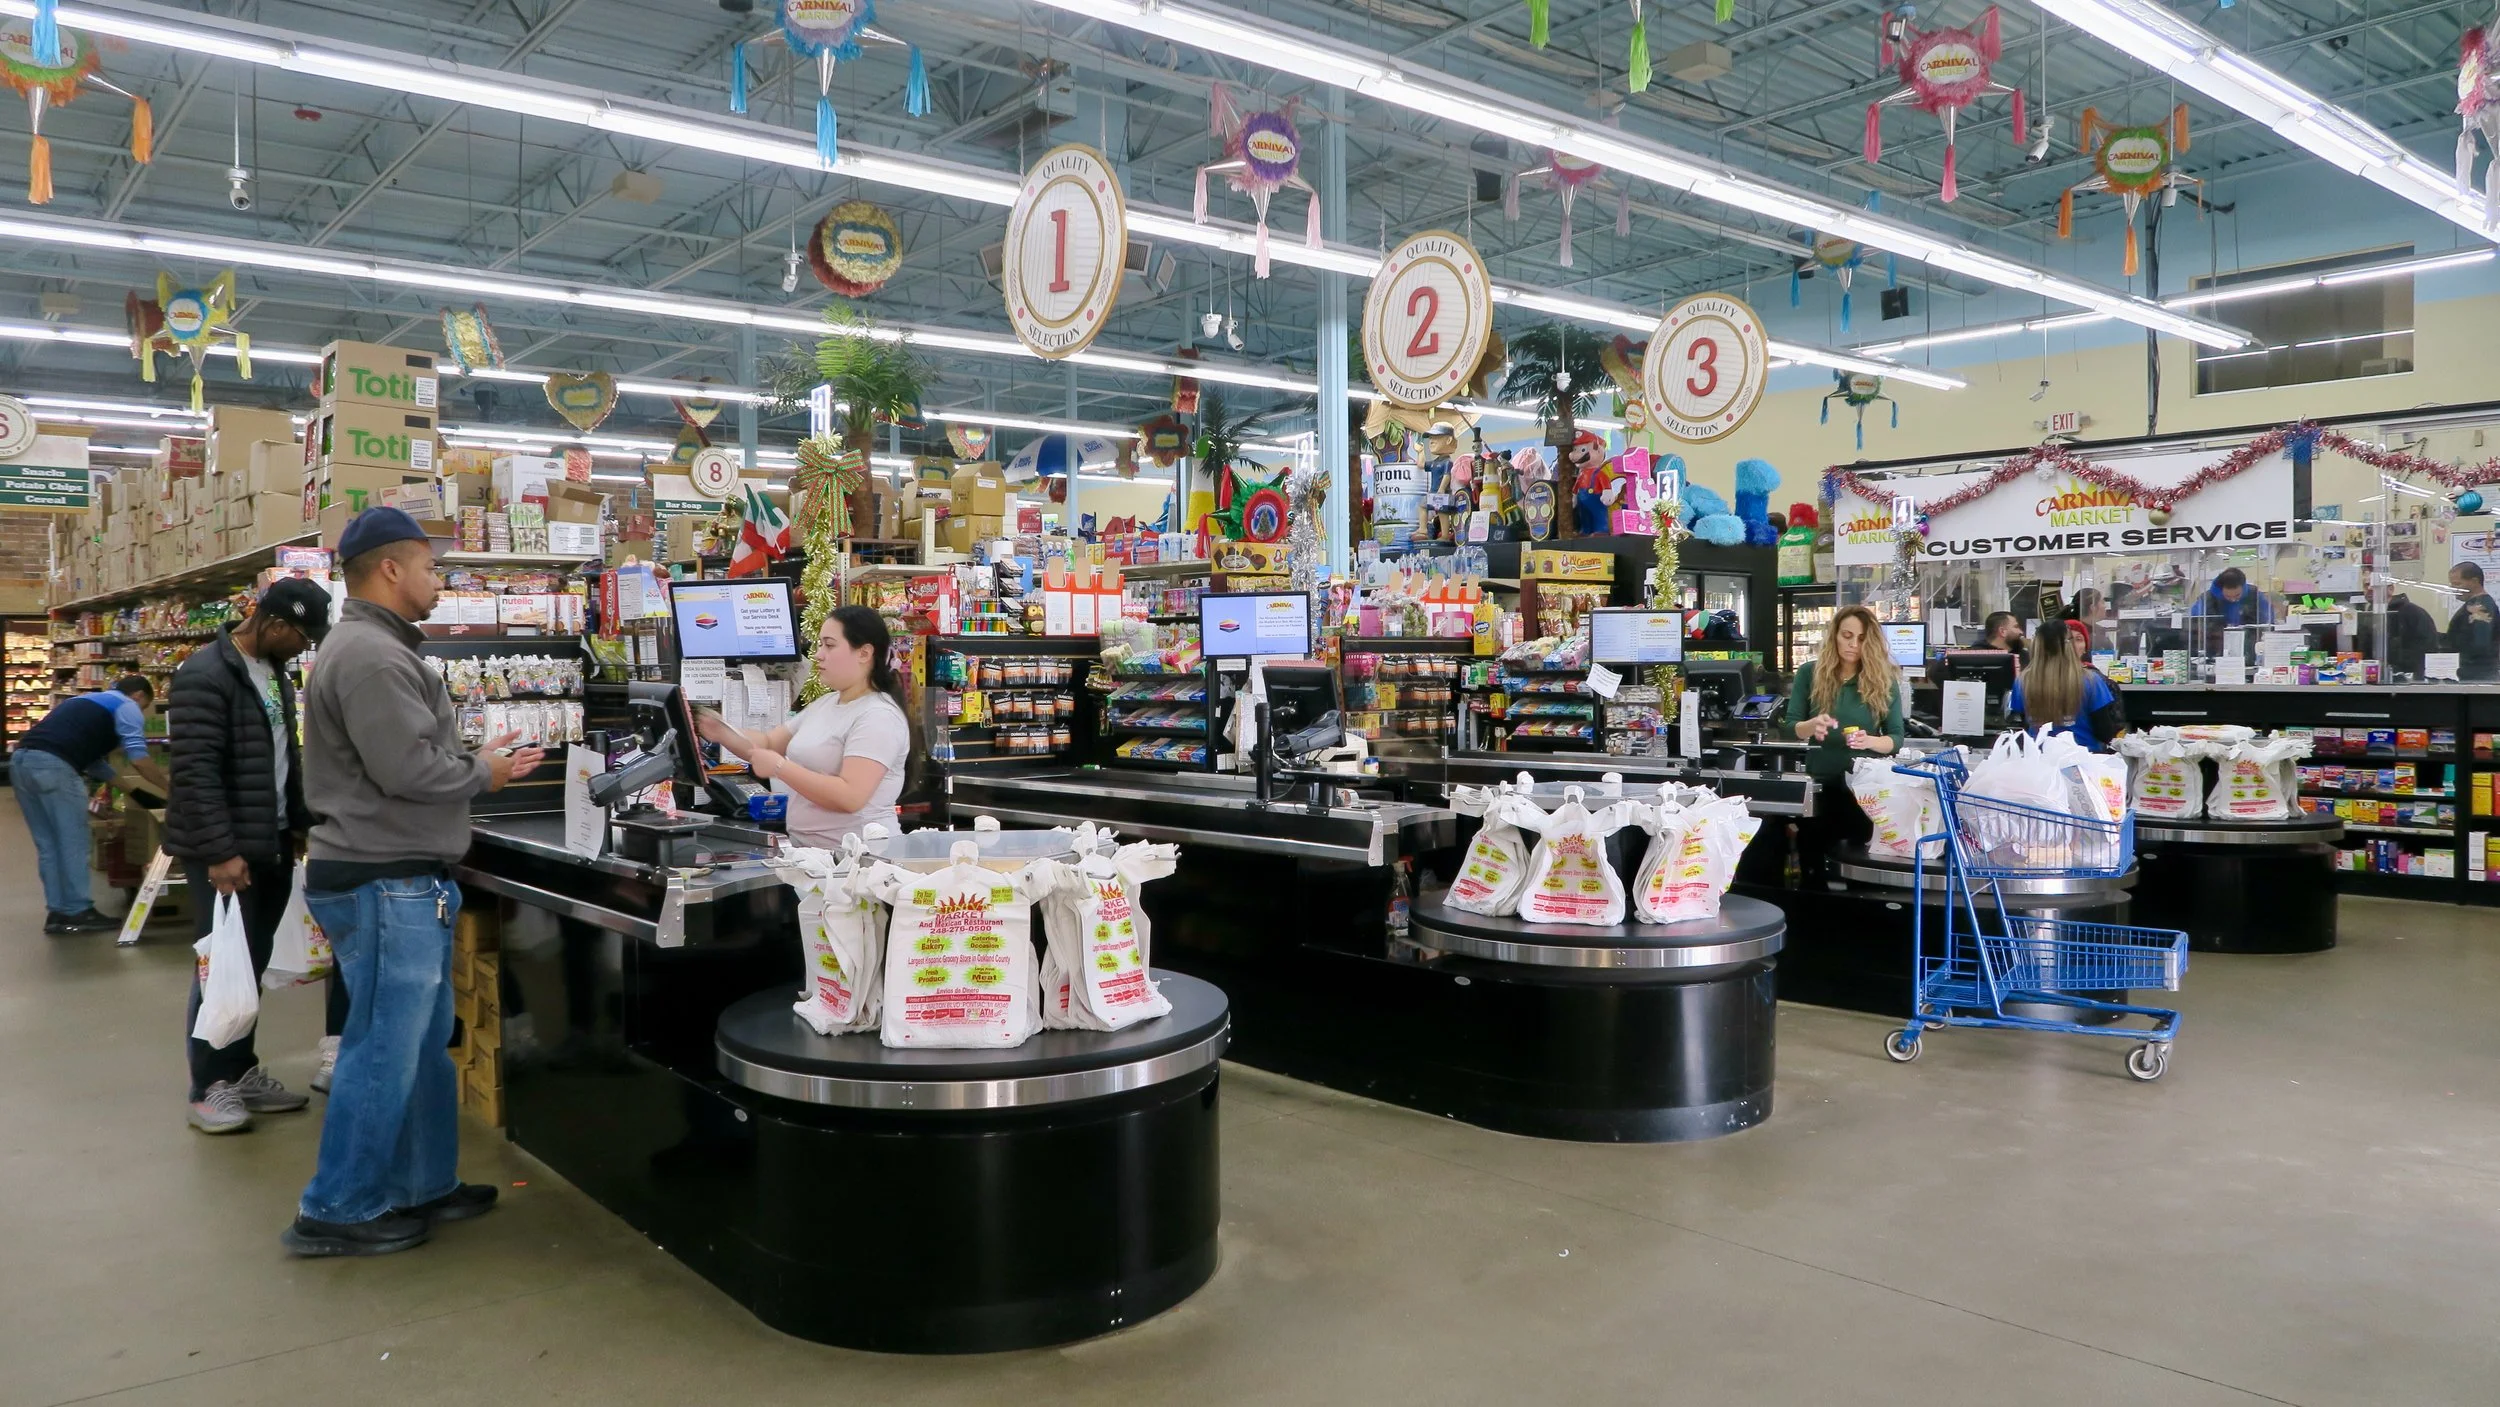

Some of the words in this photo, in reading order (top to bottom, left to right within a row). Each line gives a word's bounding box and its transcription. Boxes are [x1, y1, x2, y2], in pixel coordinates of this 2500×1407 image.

[788, 0, 853, 13] CARNIVAL
[0, 33, 75, 58] CARAL
[1920, 57, 1978, 72] CARNIVAL
[1248, 140, 1294, 155] CARNIVAL
[2108, 152, 2160, 162] CARNIVAL
[1042, 156, 1092, 179] QUALITY
[1049, 209, 1070, 293] 1
[1406, 240, 1458, 259] QUALITY
[1687, 302, 1738, 318] QUALITY
[1406, 286, 1439, 358] 2
[1027, 323, 1081, 348] SELECTION
[1686, 337, 1718, 397] 3
[1388, 378, 1444, 400] SELECTION
[1664, 416, 1719, 436] SELECTION
[2052, 412, 2074, 431] EXIT
[348, 429, 410, 460] Toti
[22, 468, 66, 478] Snacks
[710, 462, 722, 482] 8
[1375, 468, 1412, 481] orona
[6, 480, 46, 490] Potato
[48, 482, 84, 492] Chips
[1376, 484, 1400, 494] Extra
[1662, 478, 1672, 500] 3
[24, 495, 66, 504] Cereal
[681, 502, 702, 510] Soap
[1898, 500, 1908, 522] 4
[2050, 507, 2134, 528] MARKET
[1926, 532, 2110, 556] CUSTOMER
[2122, 521, 2288, 546] SERVICE
[502, 597, 534, 605] nutella
[743, 592, 775, 600] CARNIVAL
[1104, 898, 1126, 910] RKET
[936, 911, 986, 921] MARKET
[930, 926, 992, 934] 248-276-0500
[908, 957, 924, 966] Largest
[925, 957, 942, 965] Hispanic
[942, 955, 959, 964] Grocery
[995, 955, 1010, 964] County
